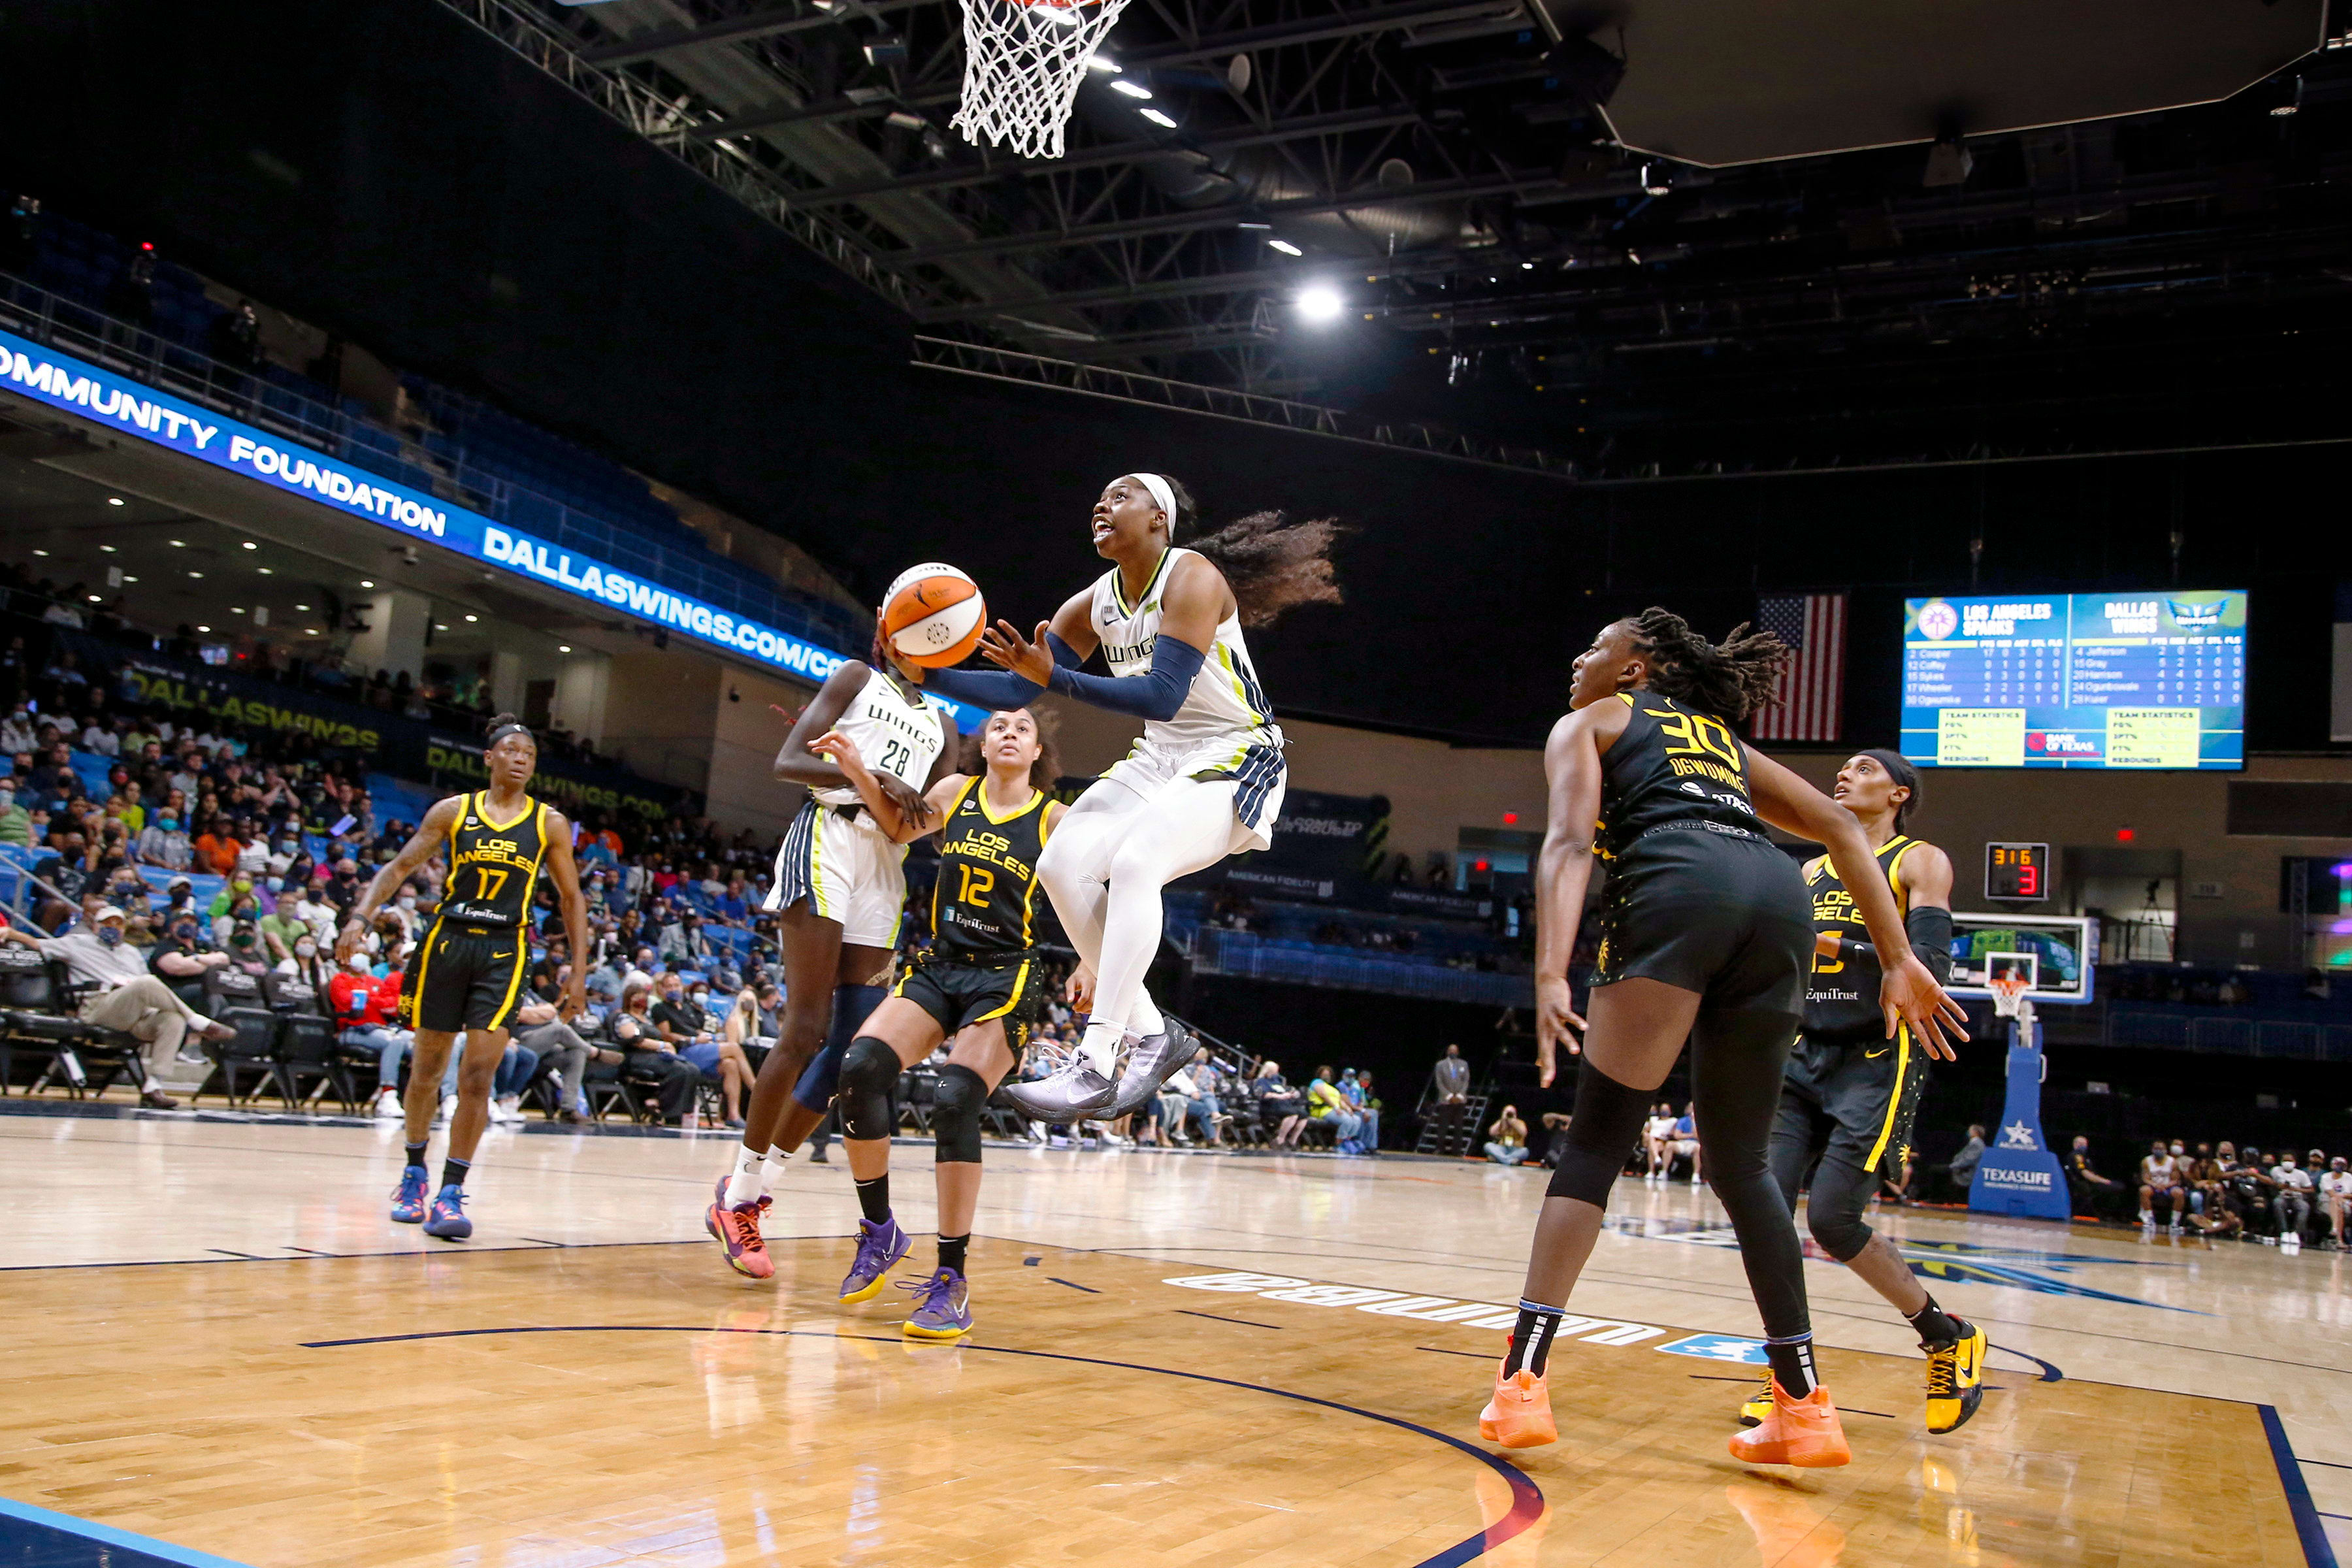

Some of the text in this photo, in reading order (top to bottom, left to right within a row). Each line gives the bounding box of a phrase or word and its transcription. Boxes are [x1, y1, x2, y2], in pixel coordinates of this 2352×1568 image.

[229, 434, 446, 538] FOUNDATION
[1963, 603, 2051, 621] LOS ANGELES
[2104, 602, 2158, 619] DALLAS
[1962, 620, 2014, 636] SPARKS
[2111, 617, 2157, 634] WINGS
[2157, 670, 2165, 679] 4
[2176, 670, 2184, 678] 4
[1642, 708, 1742, 772] 30
[2046, 734, 2076, 743] BANK
[2046, 742, 2095, 751] OF TEXAS
[880, 739, 910, 777] 28
[1669, 757, 1748, 797] OGWUMIKE
[476, 838, 517, 853] LOS
[966, 828, 1011, 852] LOS
[456, 849, 535, 875] ANGELES
[943, 841, 1030, 882] ANGELES
[476, 866, 509, 900] 17
[958, 863, 994, 909] 12
[2018, 865, 2038, 895] 3
[1812, 890, 1854, 907] LOS
[465, 907, 508, 921] EquiTrust
[956, 913, 1000, 933] EquiTrust
[1805, 988, 1859, 1003] EquiTrust
[1982, 1167, 2052, 1186] TEXASLIFE
